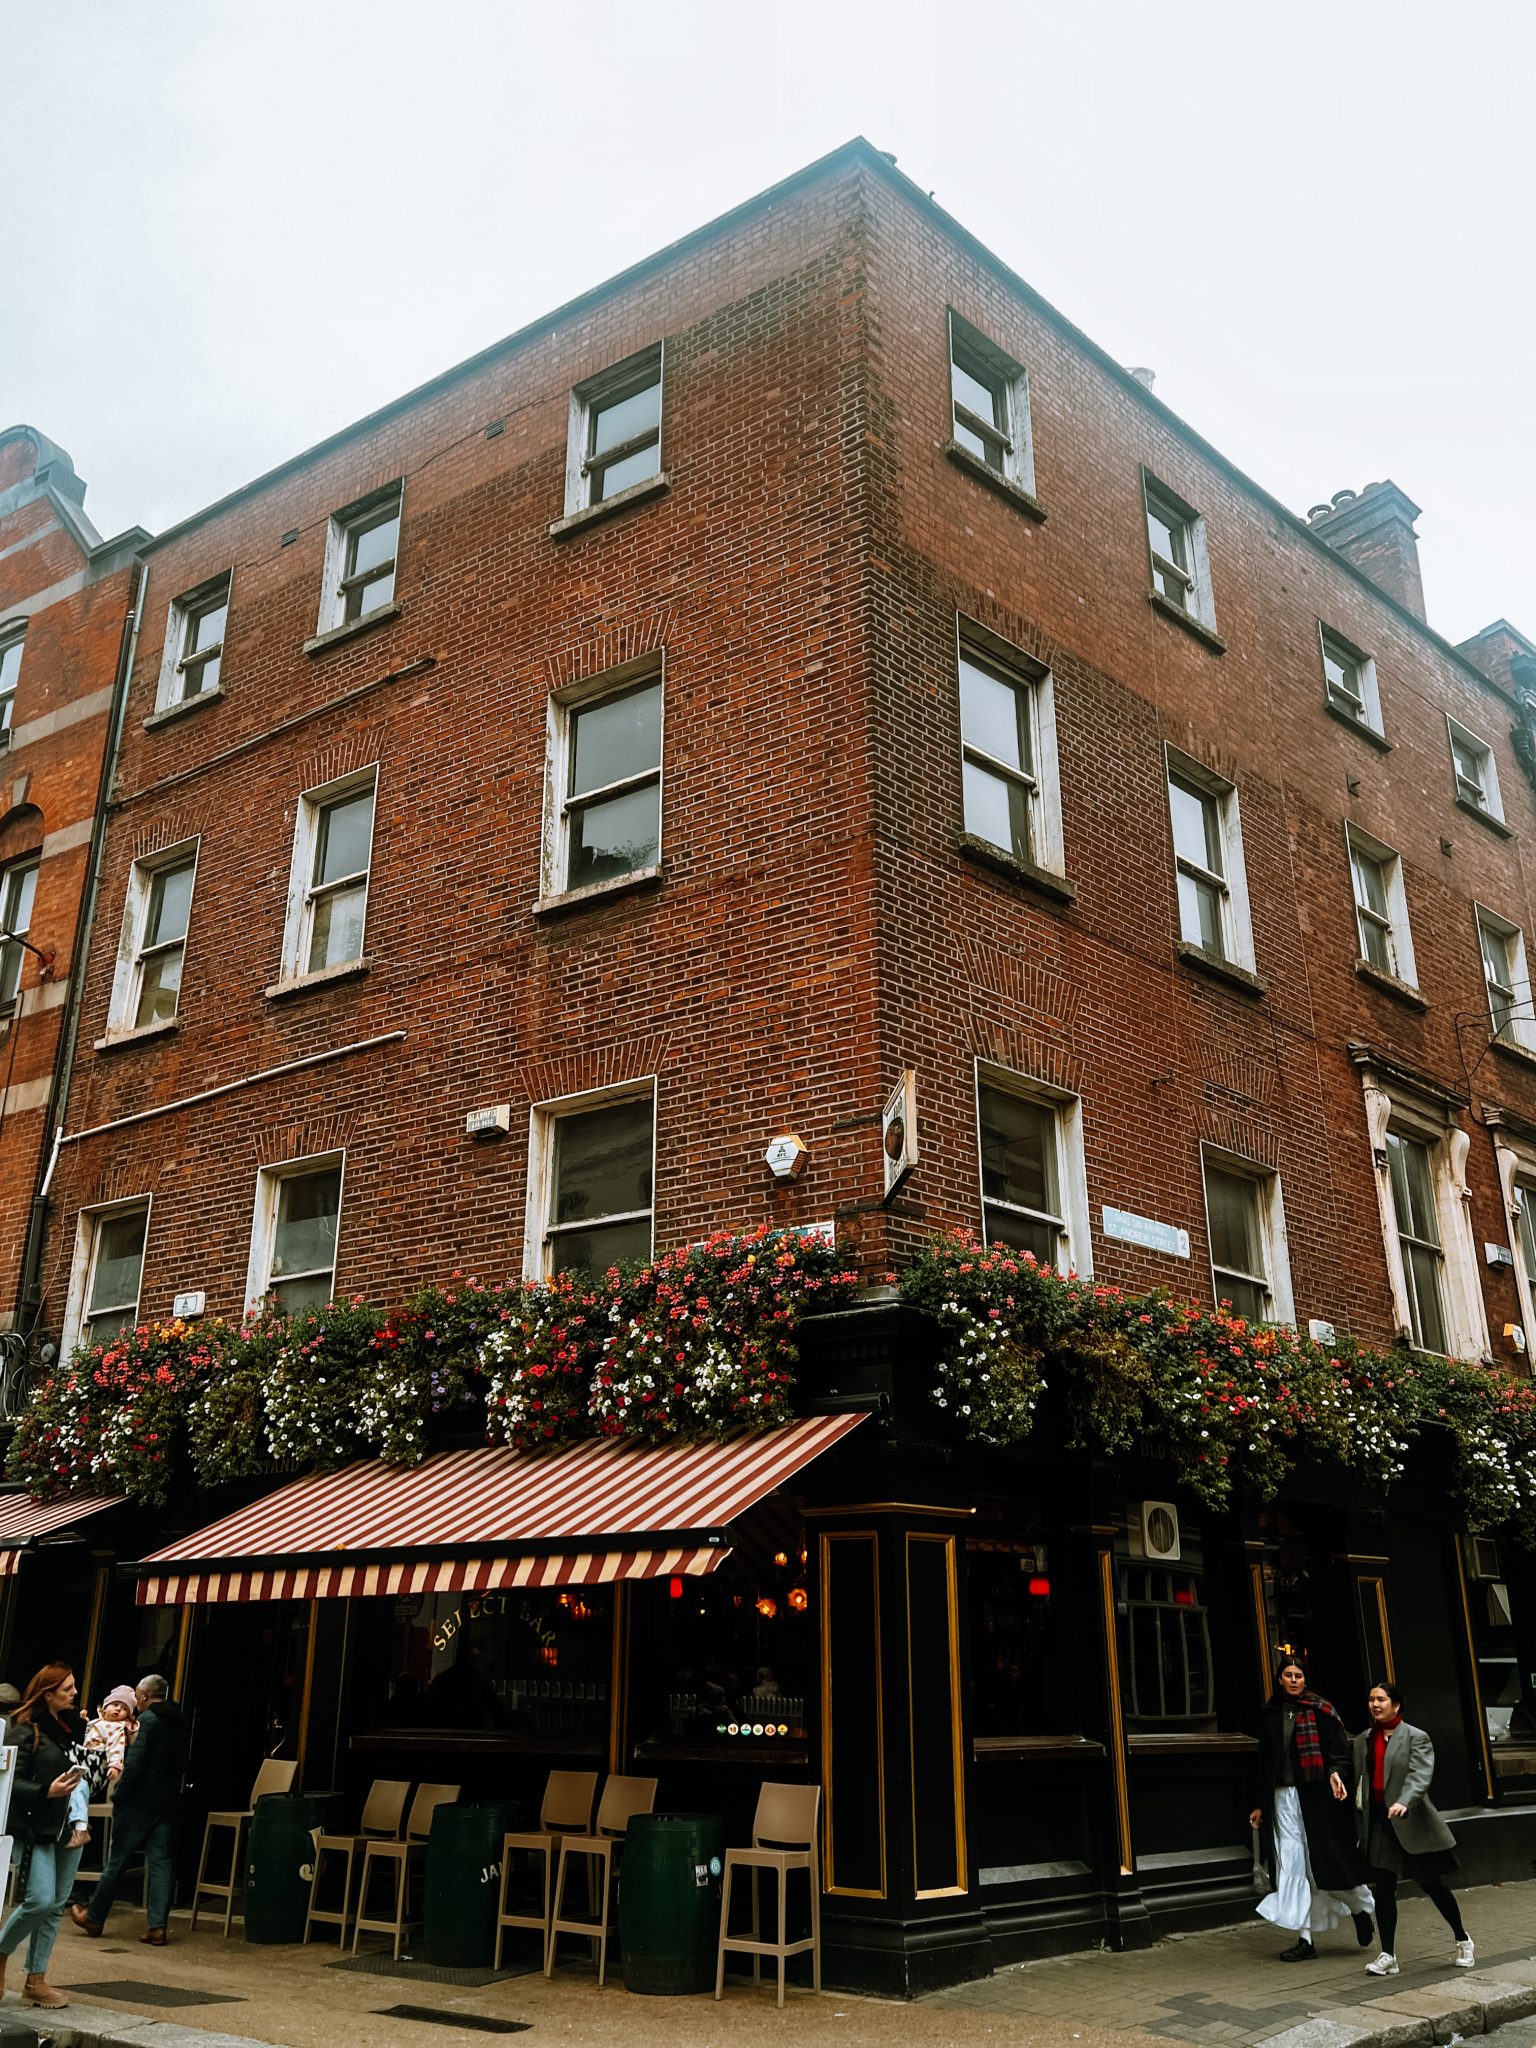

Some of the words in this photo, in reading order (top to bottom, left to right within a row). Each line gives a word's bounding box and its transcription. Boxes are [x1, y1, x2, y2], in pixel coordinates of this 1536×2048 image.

[1108, 1223, 1117, 1233] ST
[1120, 1227, 1149, 1243] ANDREW
[1151, 1236, 1175, 1251] STREET
[1180, 1236, 1187, 1250] 2
[250, 1456, 300, 1475] STAND
[433, 1596, 511, 1652] SELECT
[519, 1600, 557, 1648] BAR
